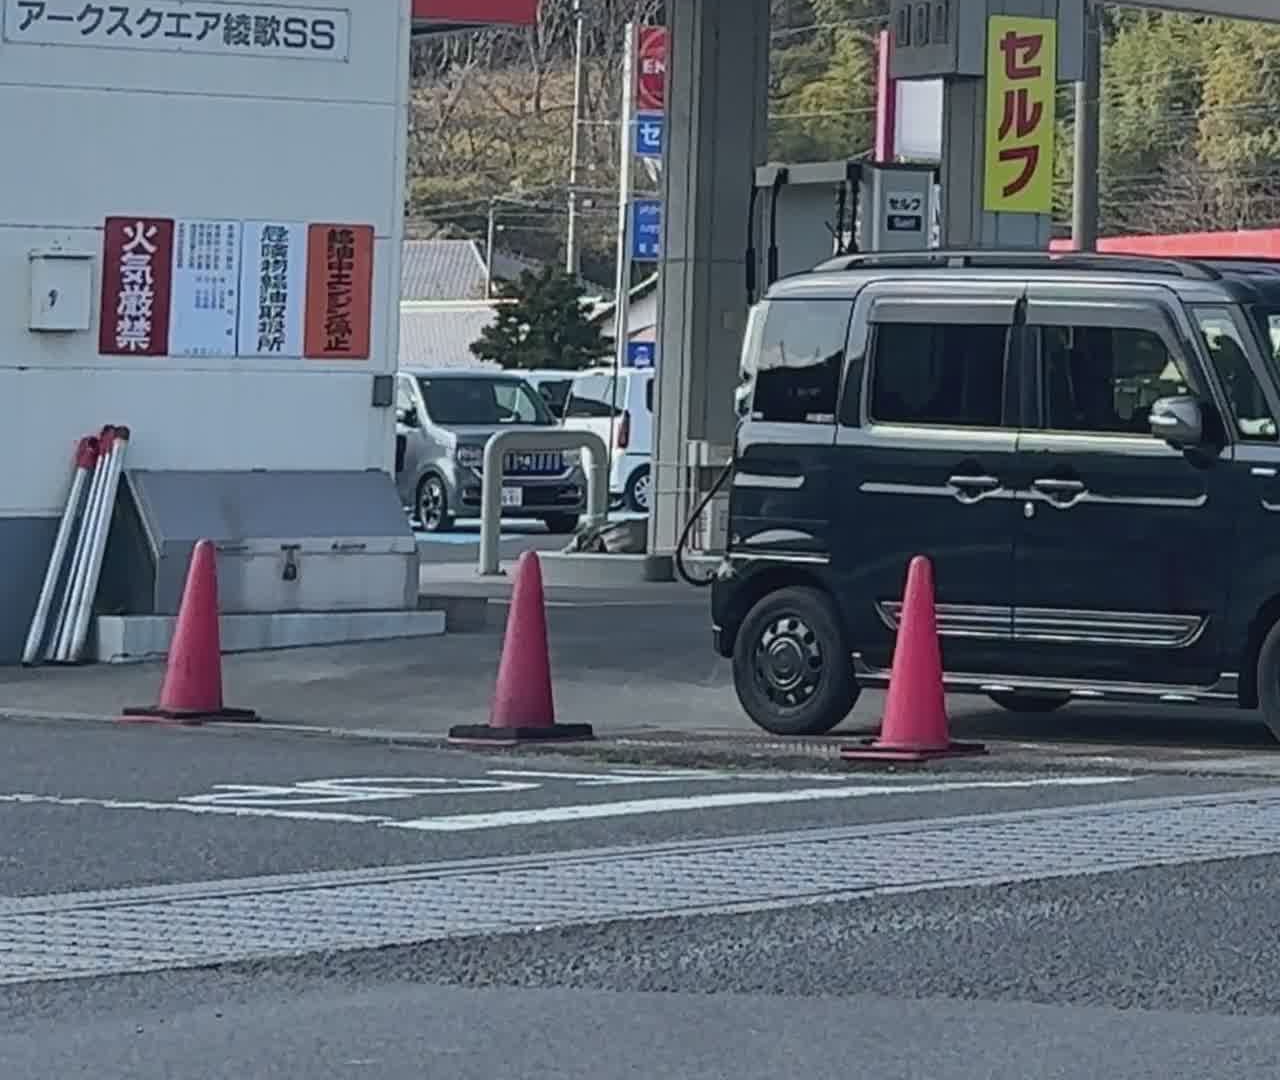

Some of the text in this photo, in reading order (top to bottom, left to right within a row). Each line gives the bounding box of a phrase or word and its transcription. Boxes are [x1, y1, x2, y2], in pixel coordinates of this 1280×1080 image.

[17, 0, 336, 50] アークスクエア綾歌SS
[997, 30, 1044, 198] セルフ
[115, 221, 157, 351] 火気厳禁
